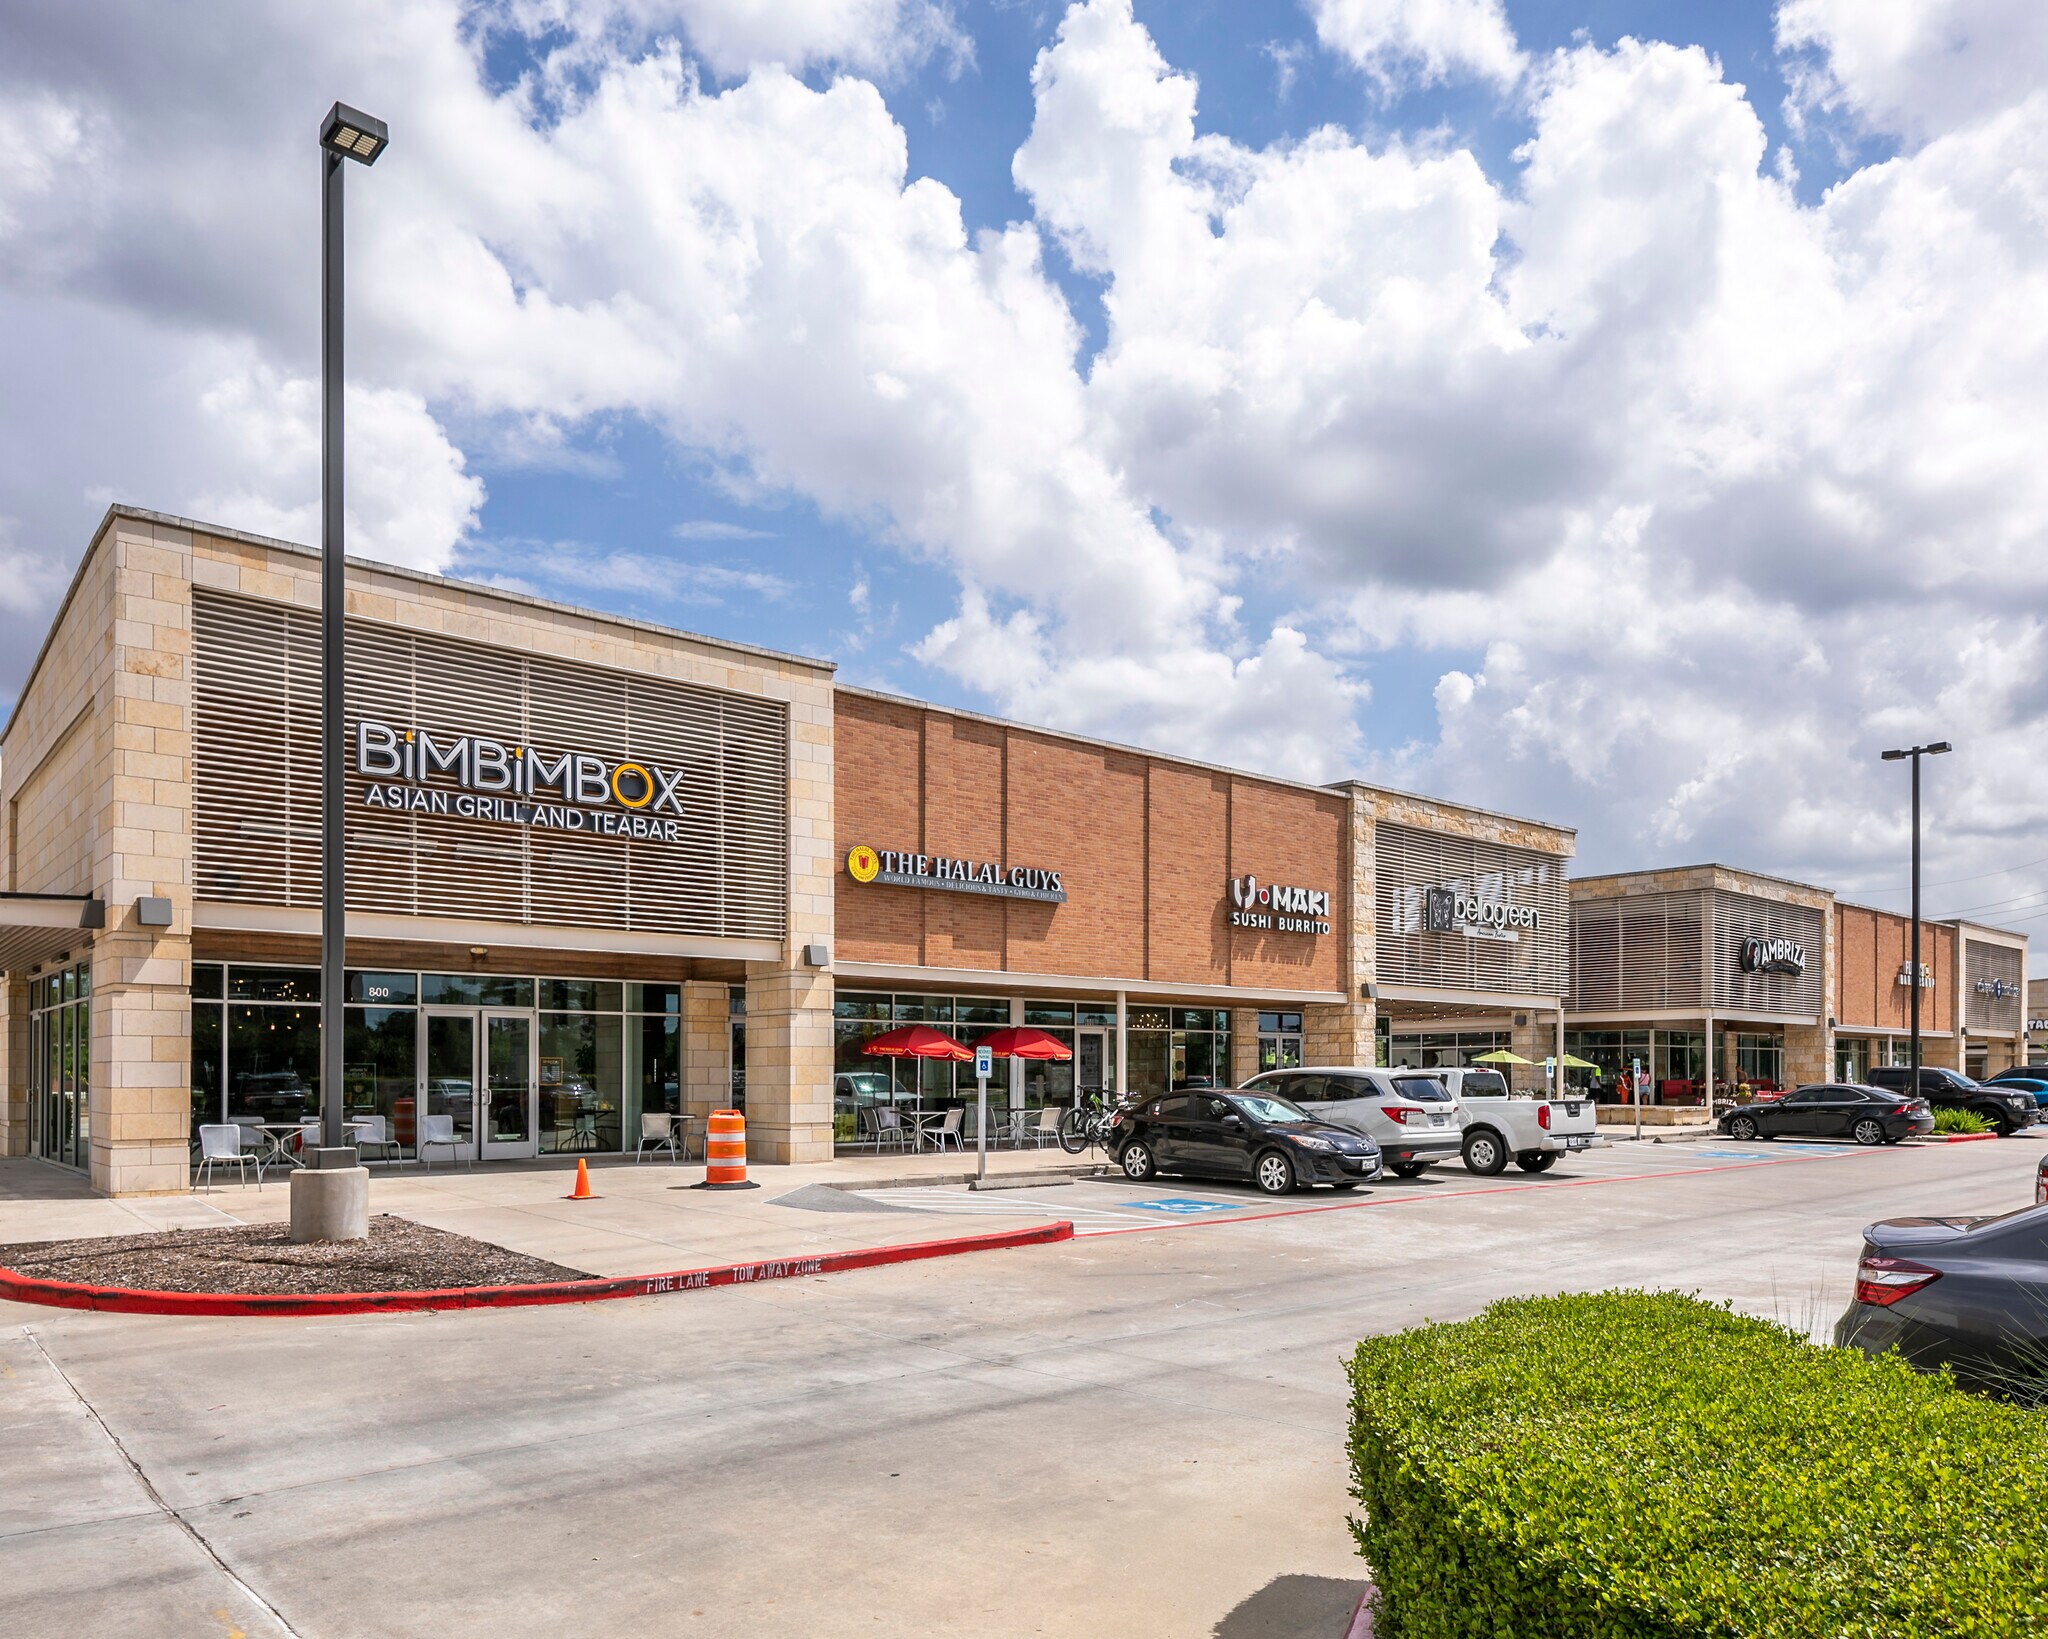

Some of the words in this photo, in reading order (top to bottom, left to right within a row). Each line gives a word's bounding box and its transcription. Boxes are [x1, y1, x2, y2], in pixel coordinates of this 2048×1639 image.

[364, 784, 448, 814] ASIAN
[456, 794, 525, 824] GRILL
[532, 804, 583, 829] AND
[590, 812, 678, 841] TEABAR
[880, 850, 928, 877] THE
[934, 857, 1006, 885] HALAL
[1011, 866, 1062, 892] GUYS
[884, 874, 910, 884] WORLD
[912, 877, 940, 887] FAMOUS
[989, 886, 1009, 895] TASTY
[1233, 911, 1271, 929] SUSHI
[1279, 917, 1331, 935] BURRITO
[1455, 892, 1540, 930] bellagreen
[1761, 939, 1806, 970] AMBRIZA
[368, 987, 389, 997] 800
[646, 1275, 675, 1294] FIRE
[679, 1271, 710, 1288] LANE
[733, 1266, 755, 1282] TOW
[758, 1262, 790, 1280] AWAY
[794, 1258, 822, 1275] ZONE
